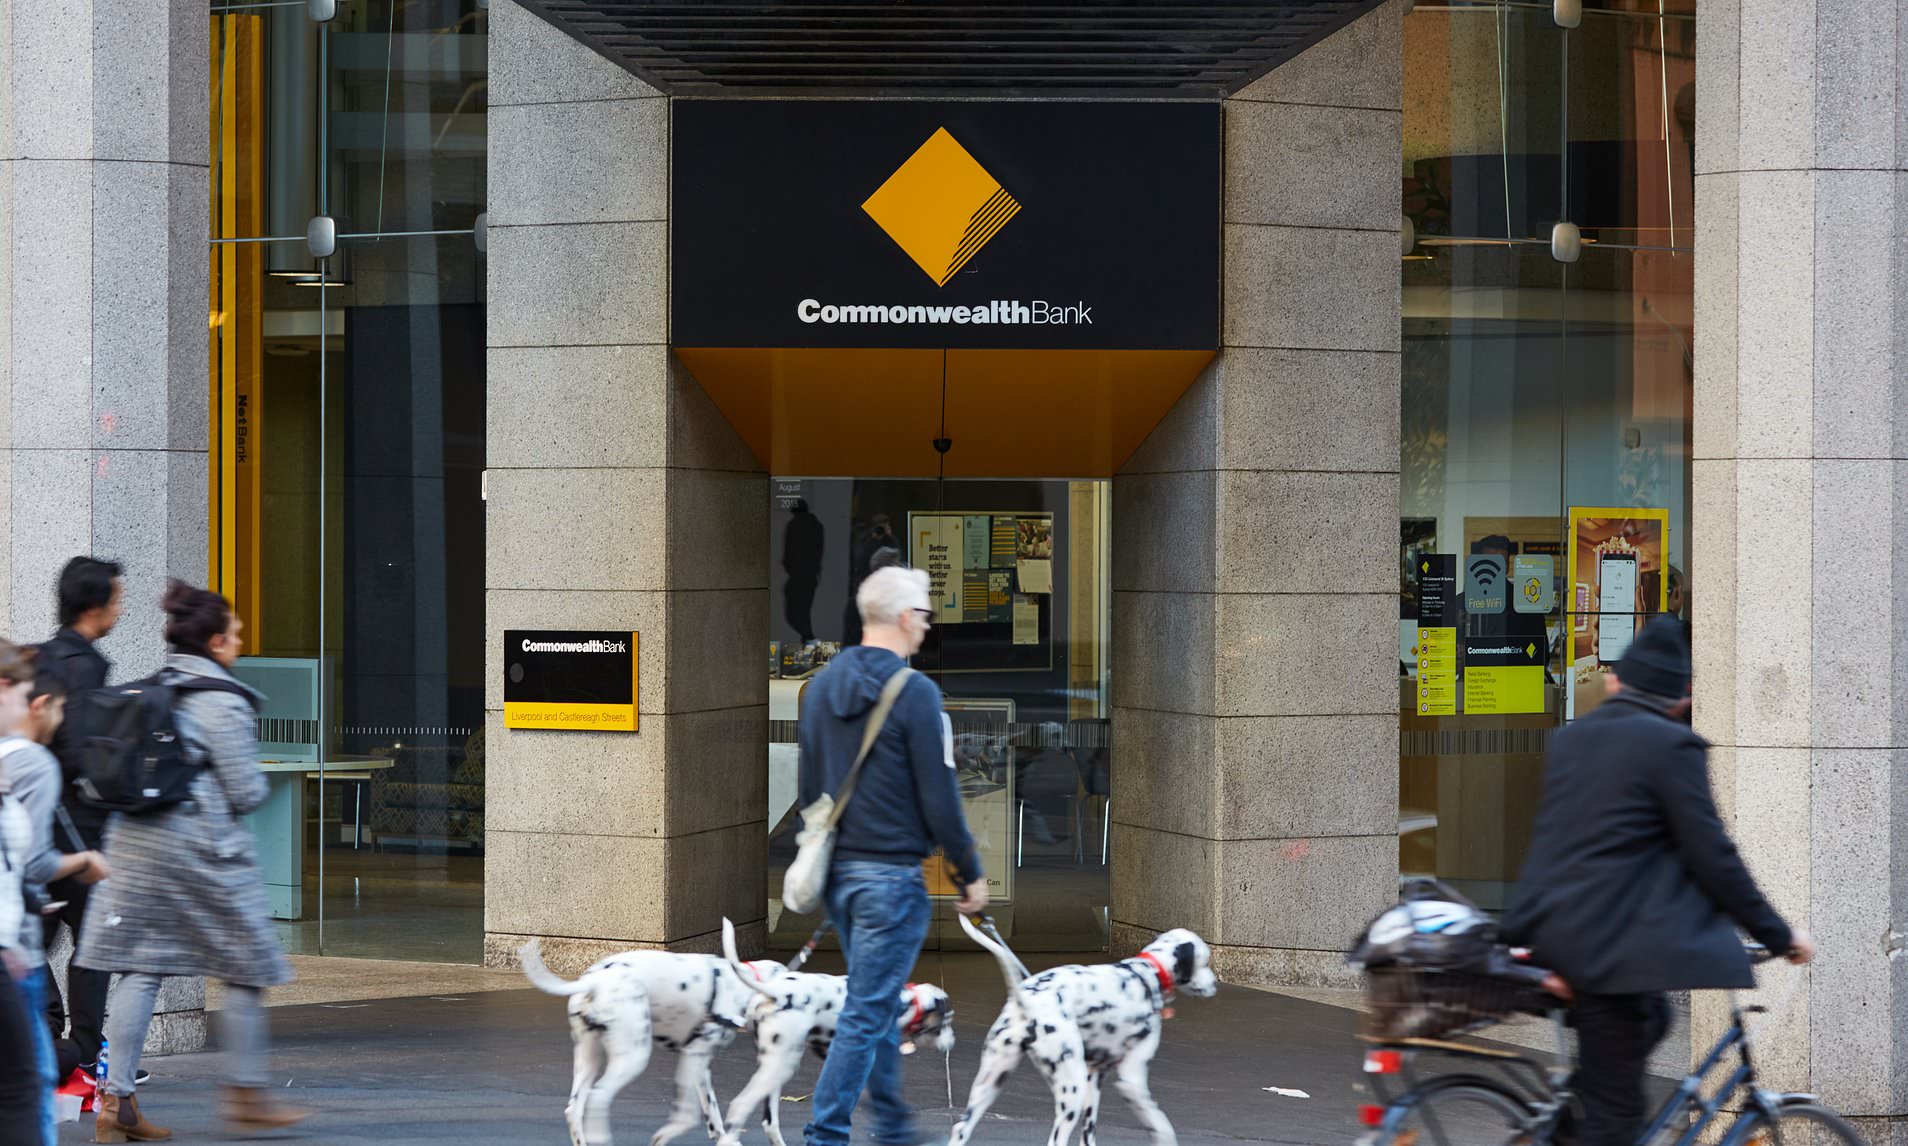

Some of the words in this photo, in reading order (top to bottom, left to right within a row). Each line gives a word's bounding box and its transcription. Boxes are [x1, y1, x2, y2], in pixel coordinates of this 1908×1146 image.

[797, 298, 1093, 325] CommonwealthBank
[238, 394, 248, 463] NetBank
[928, 544, 948, 552] Better
[1468, 598, 1484, 608] Free
[1486, 597, 1502, 608] WiFi
[521, 639, 626, 653] CommonwealthBank
[1467, 646, 1523, 654] CommonwealthBank
[511, 712, 543, 723] Liverpool
[544, 712, 556, 721] and
[559, 712, 600, 724] Castlereagh
[601, 712, 627, 723] Streets
